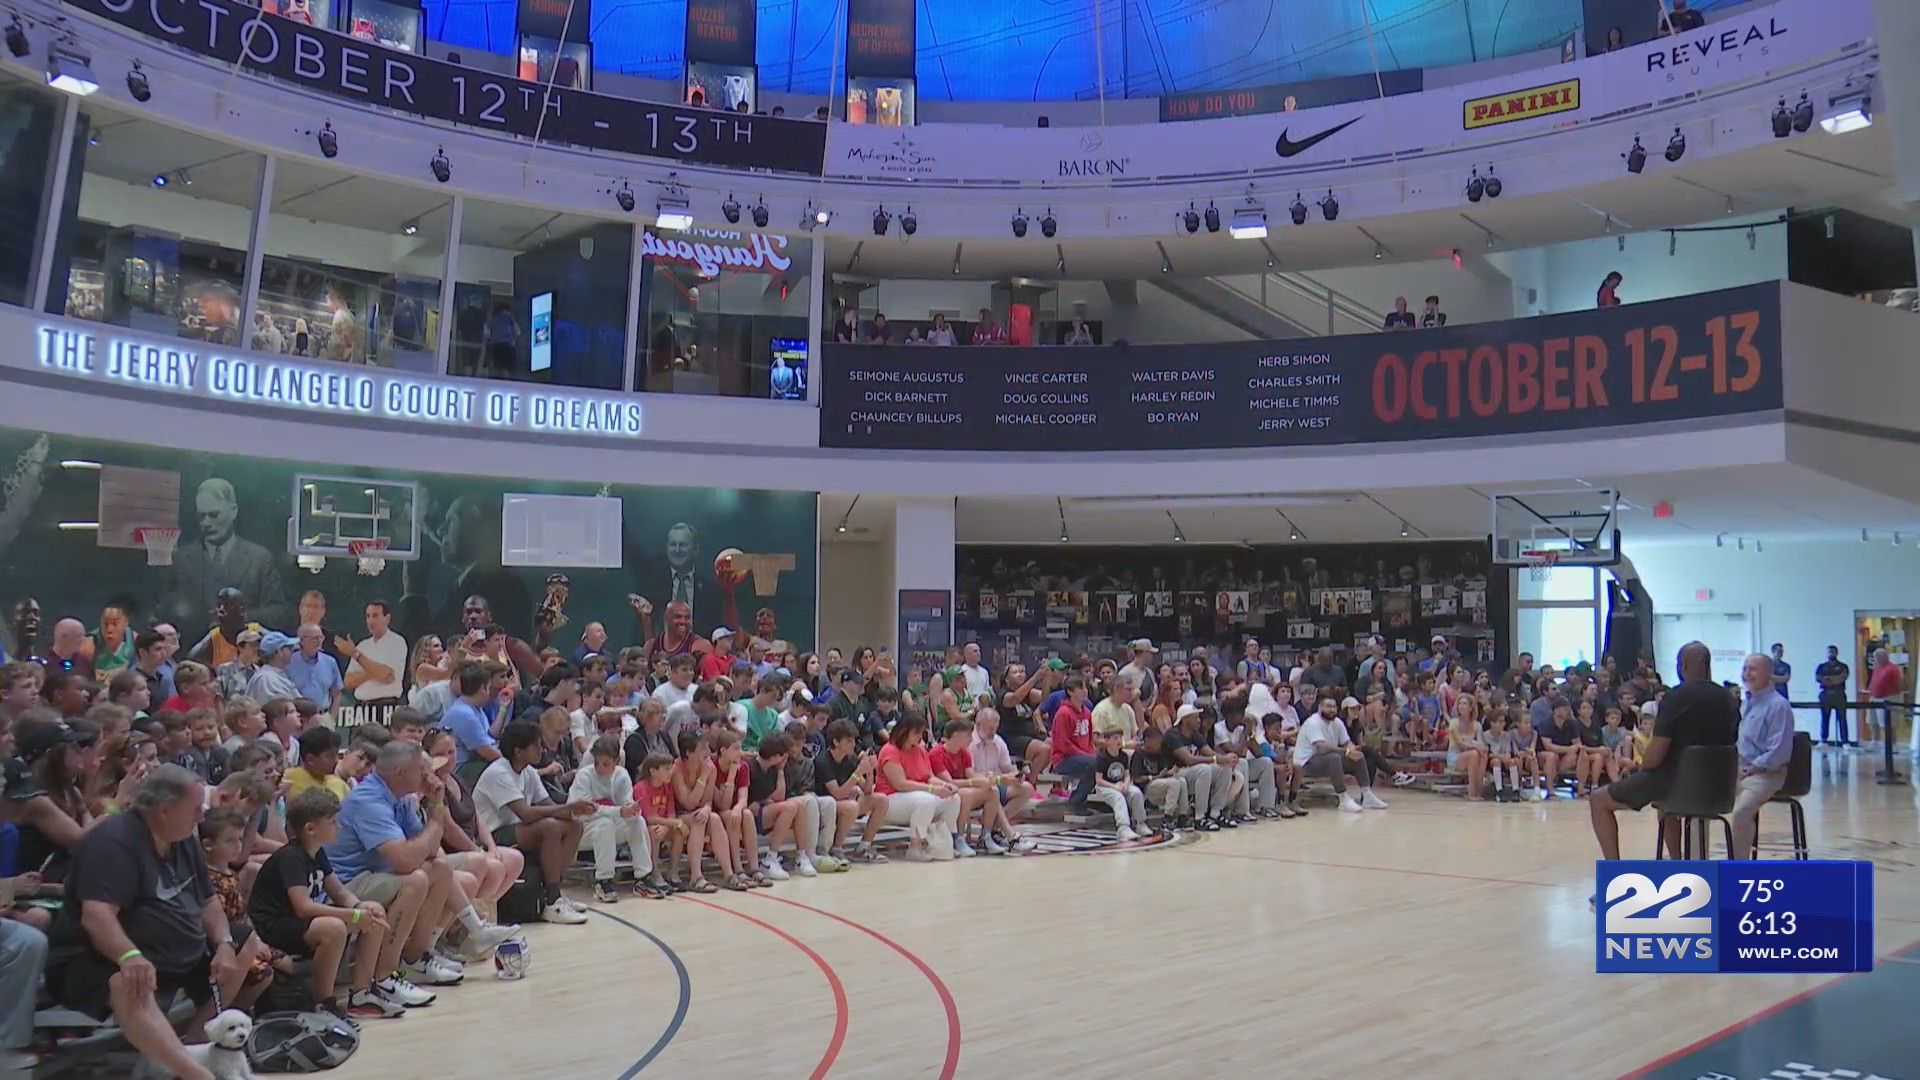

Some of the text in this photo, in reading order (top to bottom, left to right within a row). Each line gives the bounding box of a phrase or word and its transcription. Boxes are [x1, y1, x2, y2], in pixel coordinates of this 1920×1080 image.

[1647, 17, 1787, 73] REVEAL
[1666, 45, 1769, 83] SUITS
[102, 0, 416, 105] CTOBER
[646, 112, 752, 154] 13TH
[1168, 91, 1255, 117] HOW DO YOU
[1472, 87, 1572, 122] PANINI
[1258, 353, 1331, 368] HERB SIMON
[1372, 310, 1762, 424] OCTOBER 12-13
[42, 327, 641, 432] THE JERRY COLANGELO COURT OF DREAMS
[849, 370, 964, 383] SEIMONE AUGUSTUS
[1004, 373, 1088, 384] VINCE CARTER
[1131, 369, 1216, 382] WALTER DAVIS
[1248, 374, 1341, 389] CHARLES SMITH
[864, 391, 948, 403] DICK BARNETT
[1003, 393, 1089, 404] DOUG COLLINS
[1131, 391, 1216, 403] HARLEY REDIN
[1249, 395, 1340, 409] MICHELE TIMMS
[850, 411, 963, 424] CHAUNCEY BILLUPS
[995, 414, 1097, 424] MICHAEL COOPER
[1147, 412, 1199, 423] BO RYAN
[1258, 417, 1331, 430] JERRY WEST
